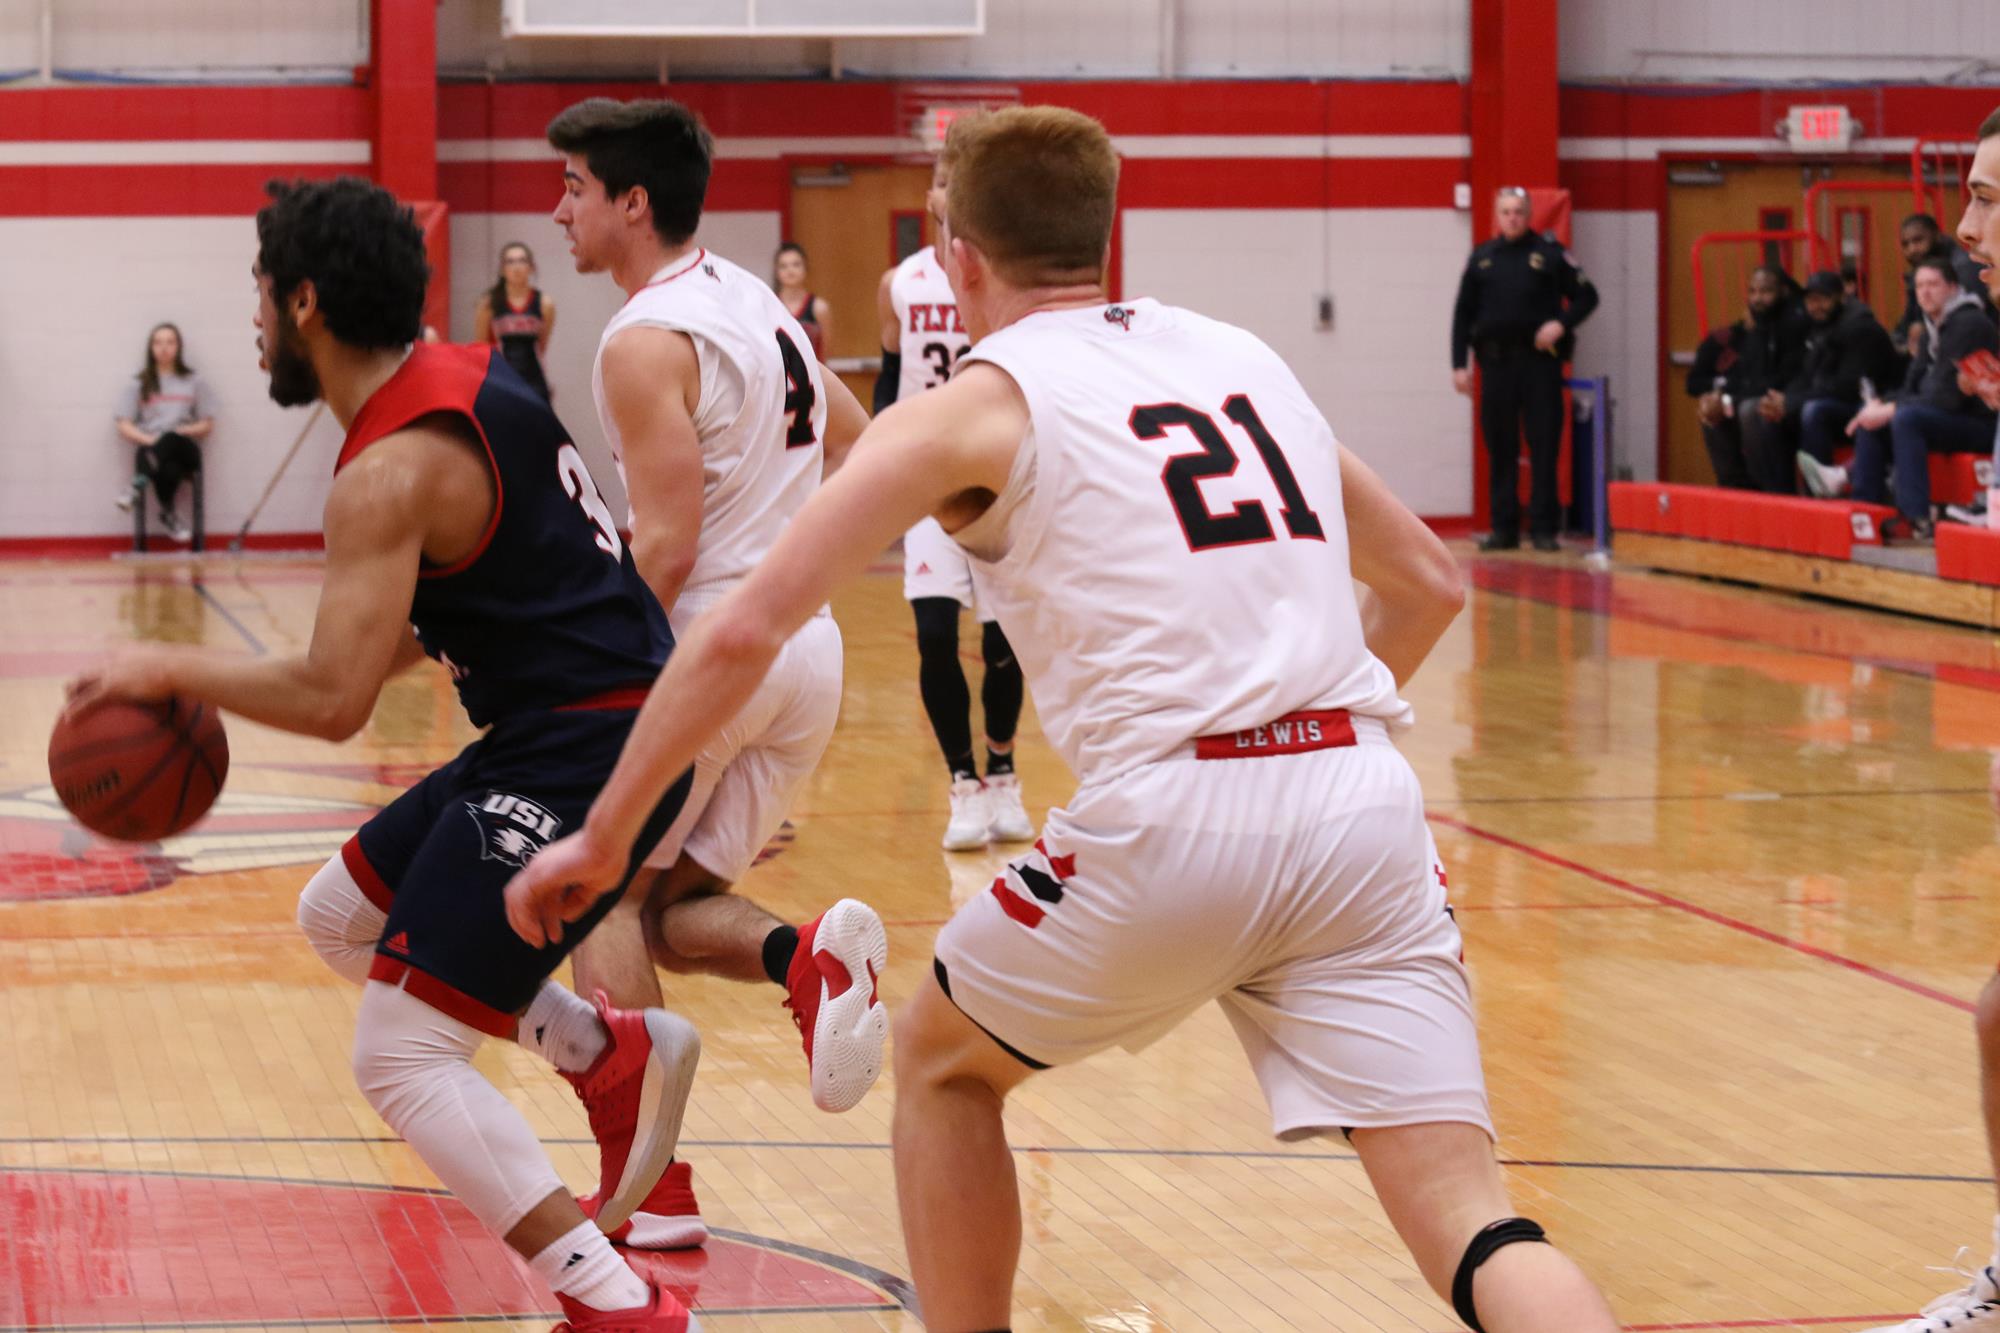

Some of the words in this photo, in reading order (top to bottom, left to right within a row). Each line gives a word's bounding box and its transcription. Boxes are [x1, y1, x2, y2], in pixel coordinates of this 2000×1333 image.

[775, 327, 817, 449] 4
[1128, 393, 1327, 553] 21
[1235, 720, 1323, 748] LEWIS
[482, 793, 557, 842] USI
